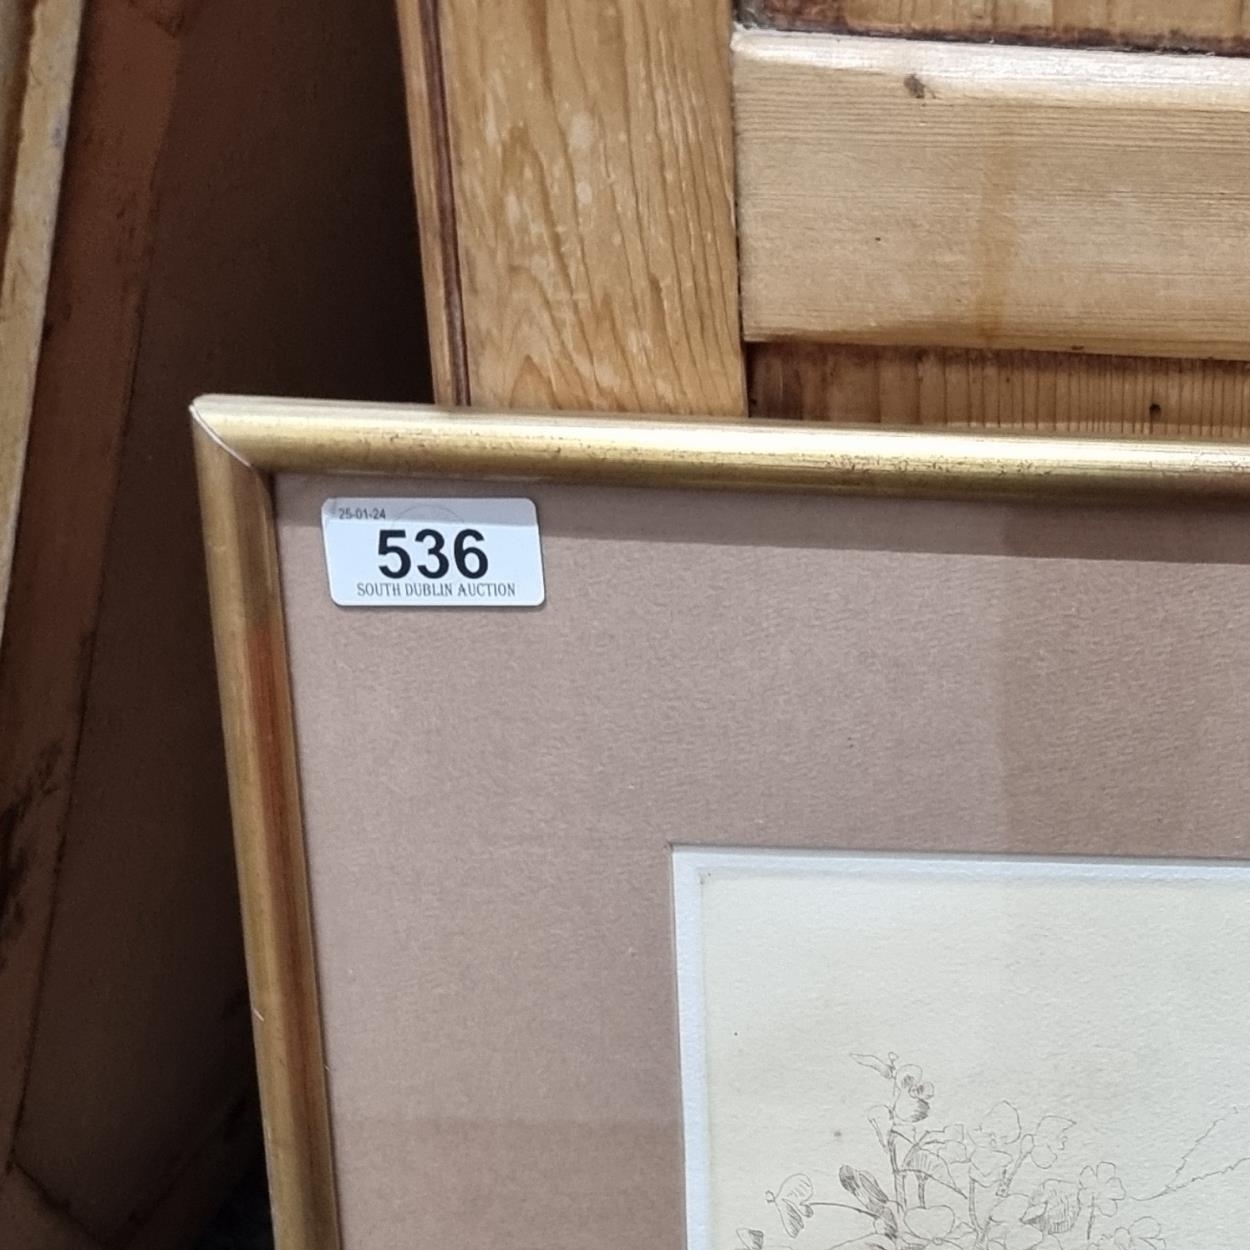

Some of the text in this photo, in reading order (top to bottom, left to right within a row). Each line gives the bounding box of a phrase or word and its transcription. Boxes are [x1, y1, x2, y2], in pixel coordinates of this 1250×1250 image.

[338, 507, 387, 521] 25-01-24
[377, 528, 489, 580] 536
[356, 582, 516, 598] SOUTH DUBLIN AUCTION
